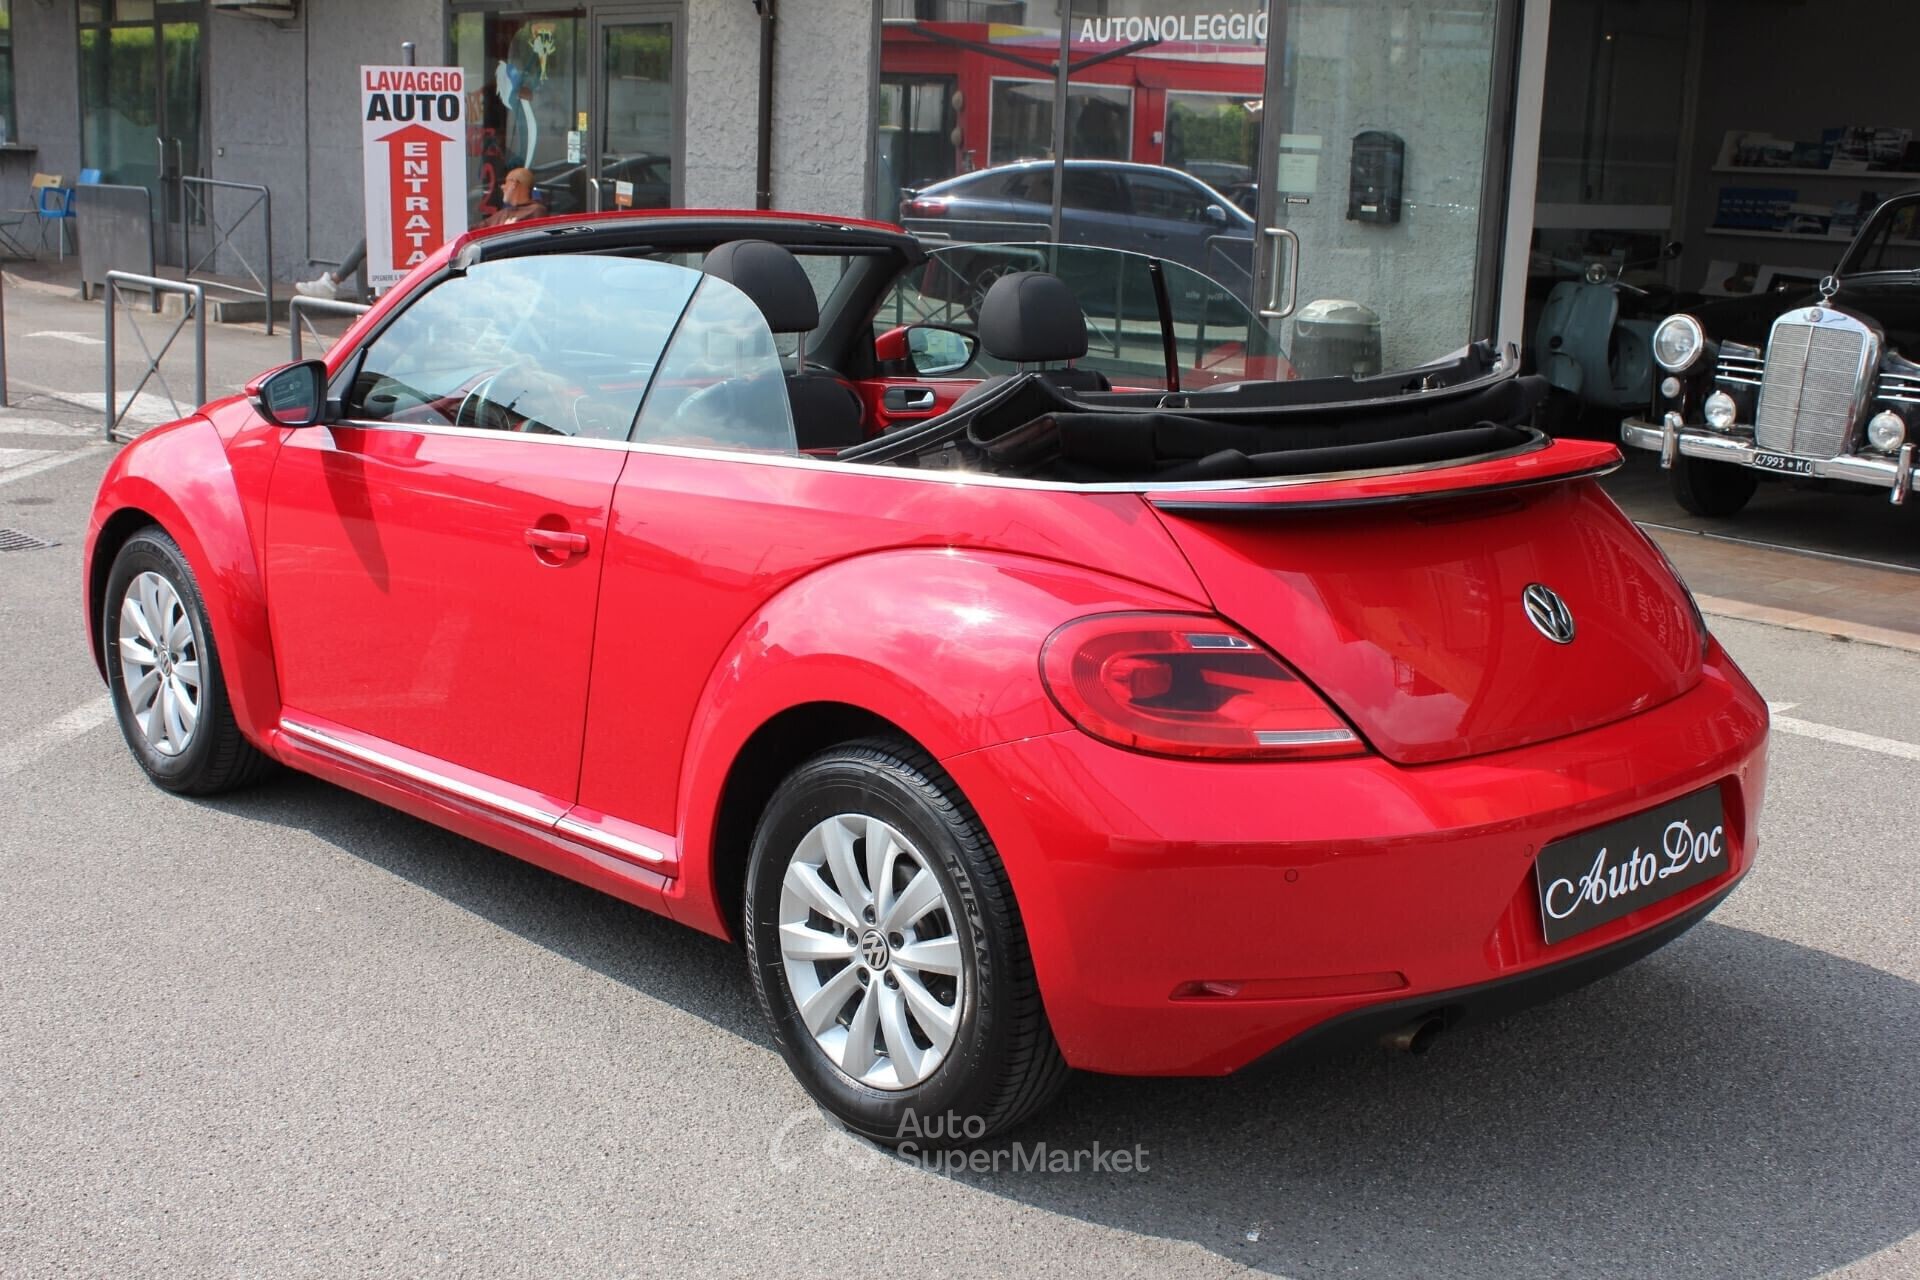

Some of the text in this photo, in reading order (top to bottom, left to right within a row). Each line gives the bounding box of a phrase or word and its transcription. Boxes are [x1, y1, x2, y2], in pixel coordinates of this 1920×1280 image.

[1079, 13, 1268, 43] AUTONOLEGGIO
[366, 71, 462, 92] LAVAGGIO
[366, 93, 460, 122] AUTO
[403, 141, 431, 266] ENTRATA
[1754, 454, 1785, 468] 47993
